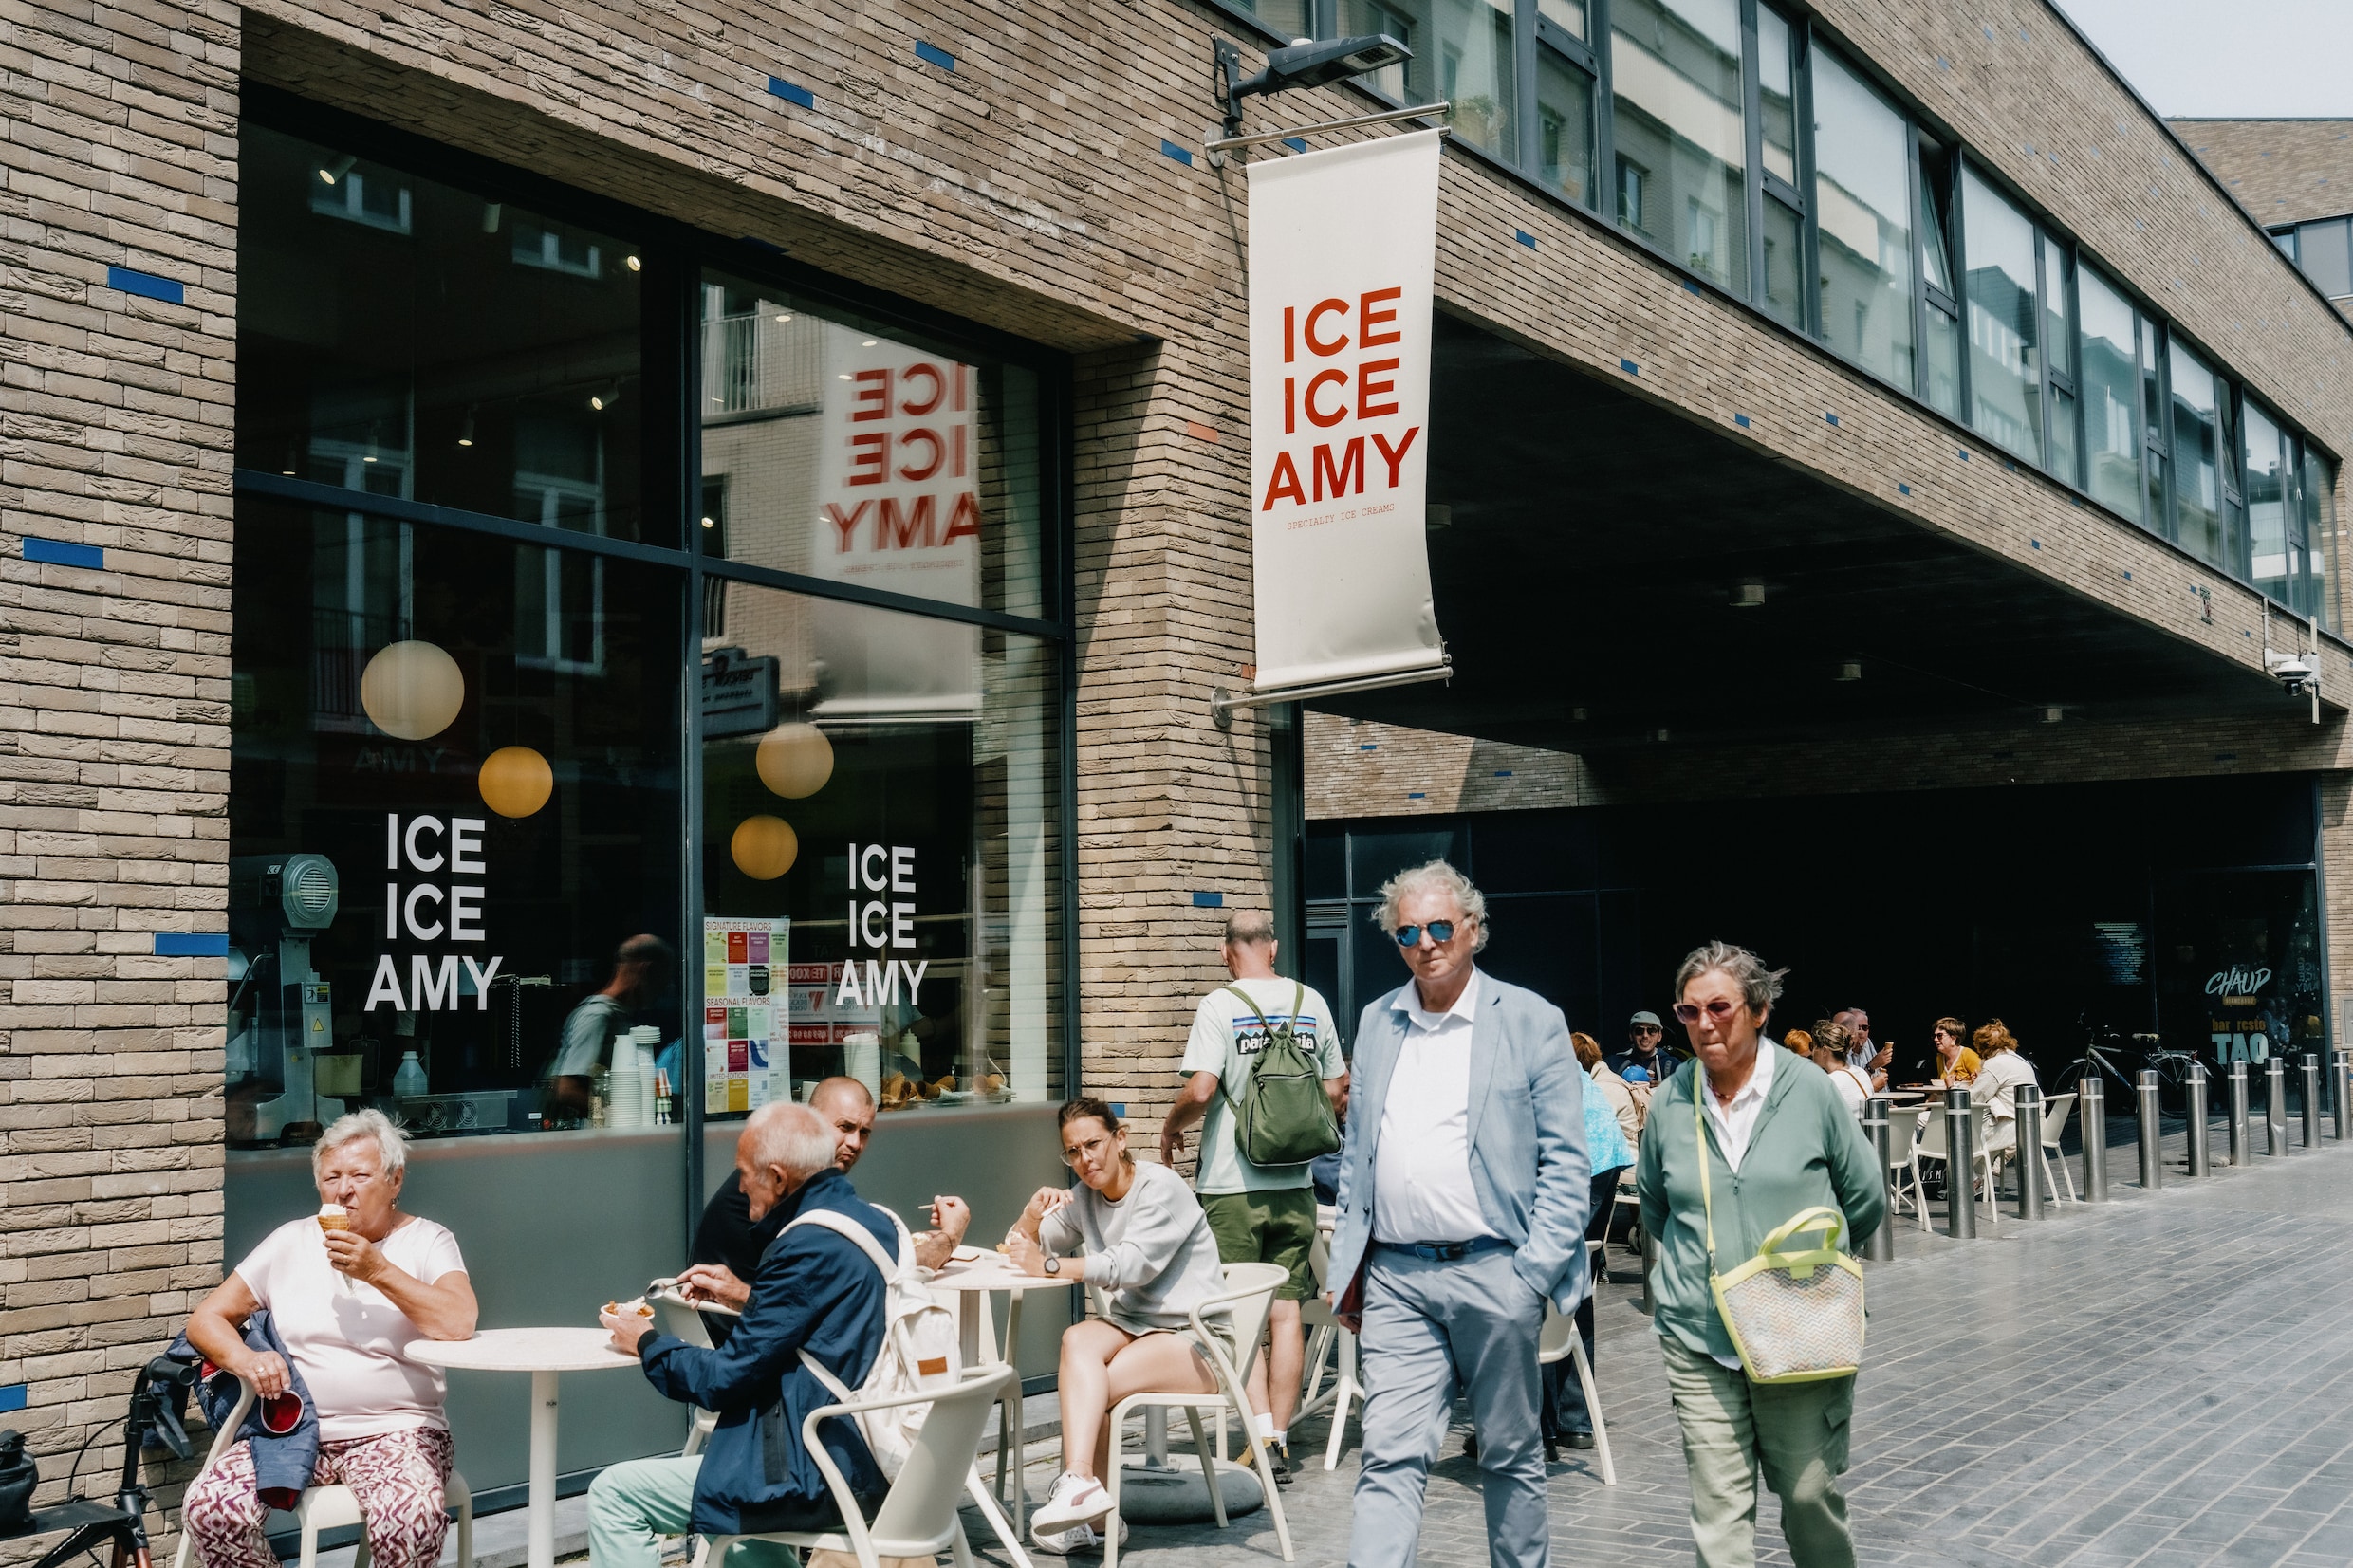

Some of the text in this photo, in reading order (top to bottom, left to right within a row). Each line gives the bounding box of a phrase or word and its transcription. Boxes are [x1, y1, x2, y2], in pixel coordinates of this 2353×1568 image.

[1284, 286, 1402, 364] ICE
[1284, 357, 1399, 434] ICE
[1262, 426, 1420, 511] AMY
[1287, 504, 1395, 530] SPECIALTY ICE CREAMS
[387, 813, 487, 874] ICE
[848, 842, 917, 894] ICE
[386, 882, 486, 941] ICE
[705, 921, 772, 932] SIGNATURE FLAVORS
[849, 900, 917, 949] ICE
[364, 954, 504, 1012] AMY
[706, 997, 771, 1007] SEASONAL FLAVORS
[835, 959, 929, 1006] AMY
[2204, 967, 2272, 996] CHAUD
[2211, 1032, 2270, 1065] TAO
[2212, 1018, 2267, 1032] bar resto
